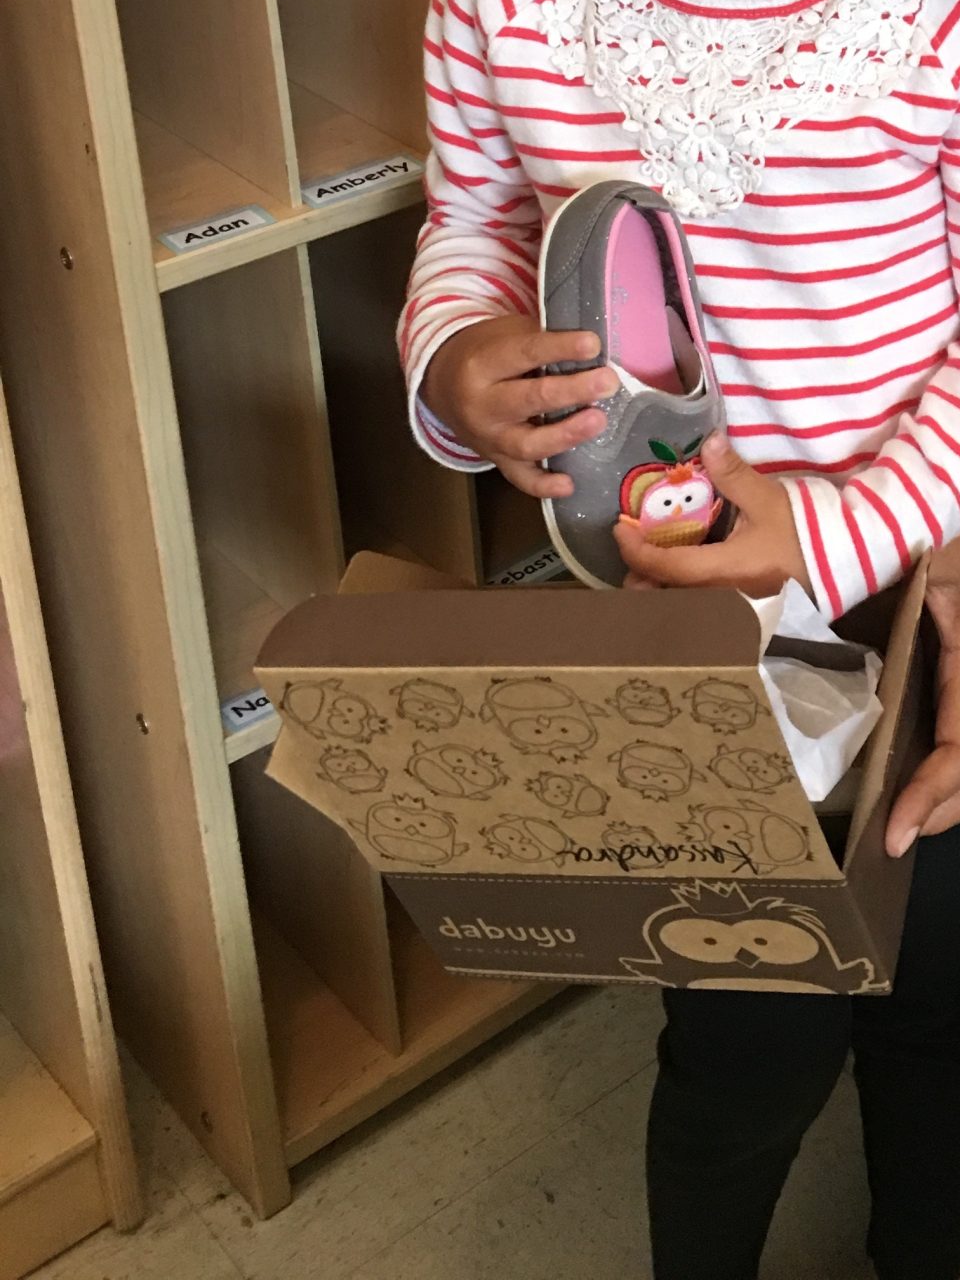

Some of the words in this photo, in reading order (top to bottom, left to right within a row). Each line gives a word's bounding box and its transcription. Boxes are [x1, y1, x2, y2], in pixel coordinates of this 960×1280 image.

[316, 161, 409, 199] Amberly
[184, 218, 250, 244] Adan
[488, 549, 560, 584] ebasti
[439, 916, 576, 948] dabuyu
